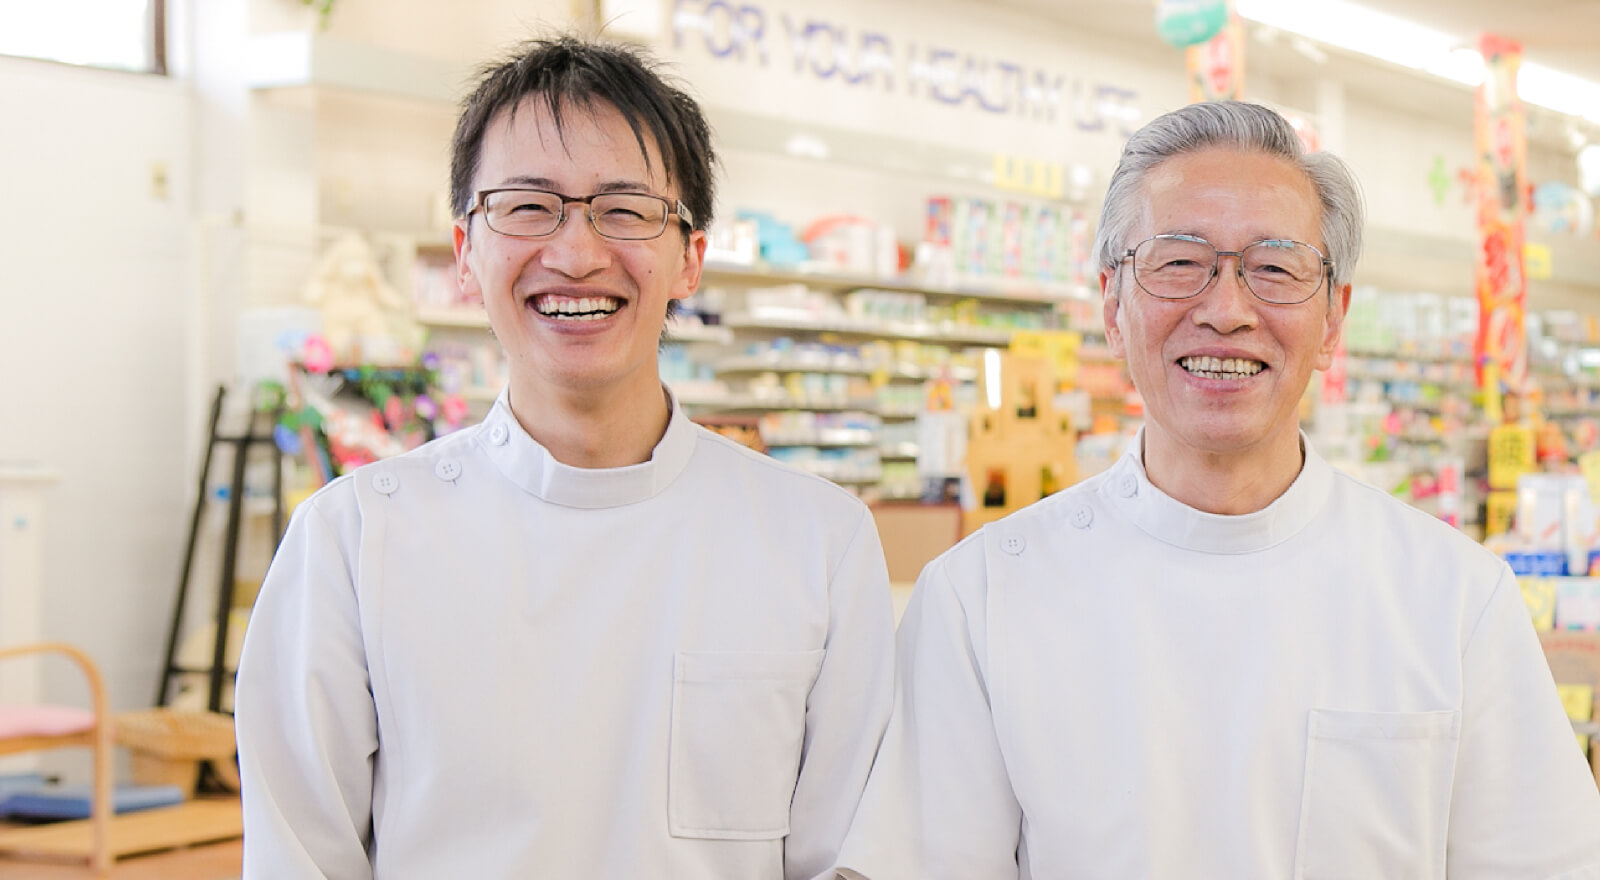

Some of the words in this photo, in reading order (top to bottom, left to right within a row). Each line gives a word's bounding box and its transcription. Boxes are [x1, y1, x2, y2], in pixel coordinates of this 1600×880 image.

[673, 0, 769, 69] FOR
[780, 13, 895, 92] YOUR
[907, 42, 1065, 123] HEALTHY
